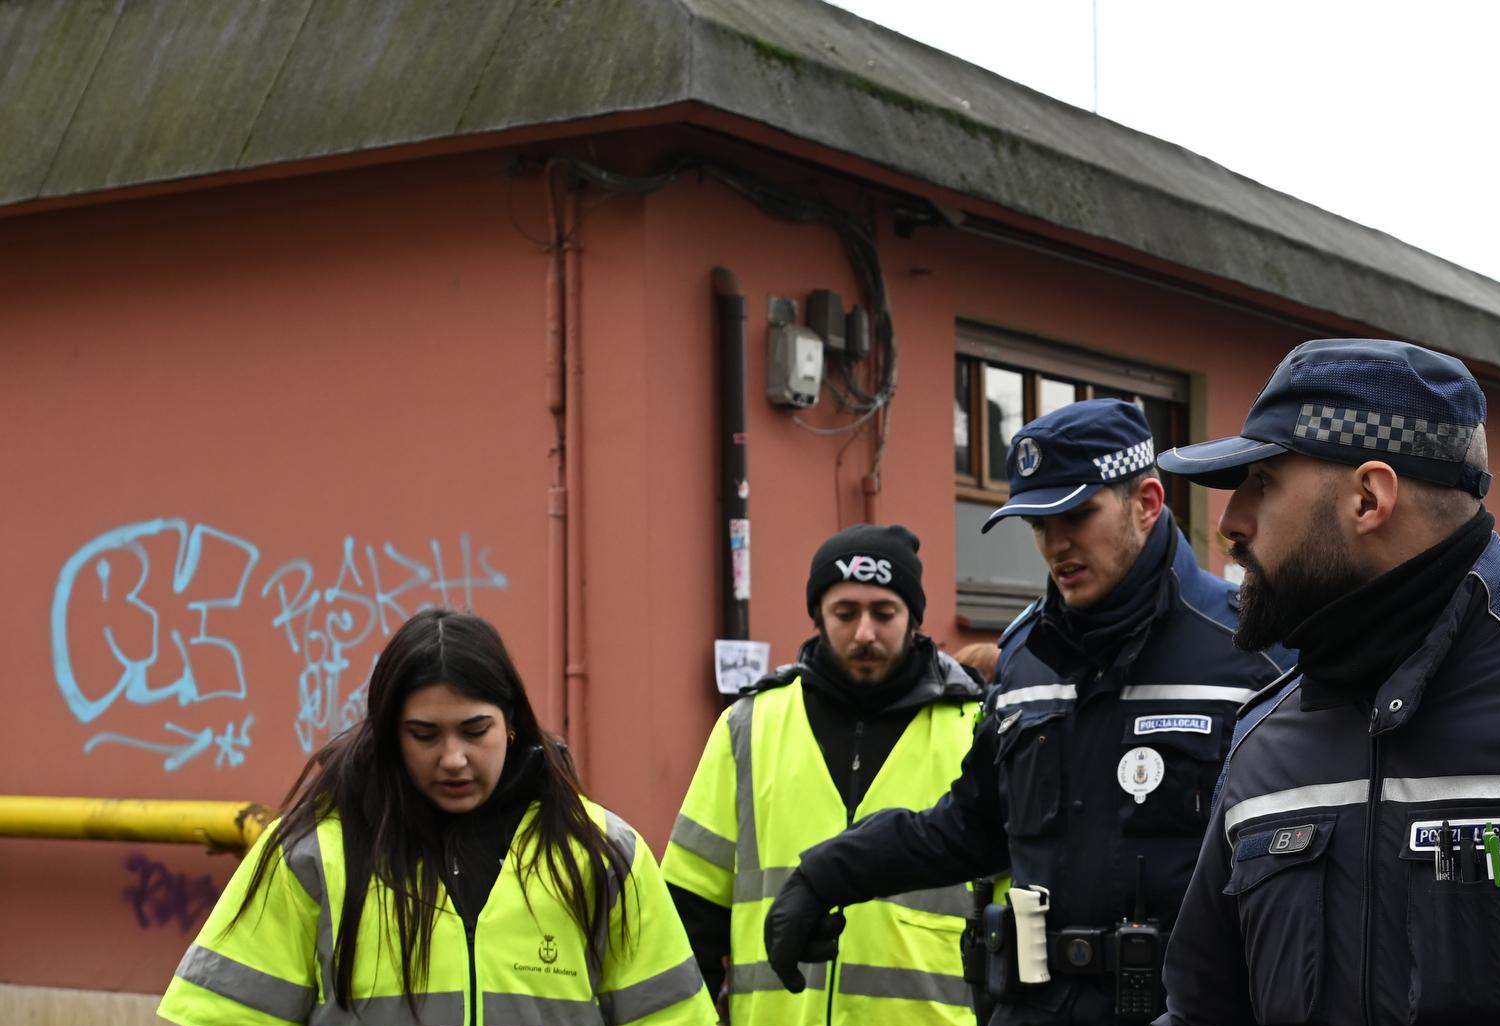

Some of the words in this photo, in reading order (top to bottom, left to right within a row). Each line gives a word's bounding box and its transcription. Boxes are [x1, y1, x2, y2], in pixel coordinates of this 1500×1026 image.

[1140, 719, 1172, 730] POLIZIA
[1174, 718, 1207, 729] LOCALE
[1276, 832, 1292, 849] B
[1420, 828, 1461, 843] POZI
[513, 962, 542, 972] Comune
[553, 967, 577, 977] Modena
